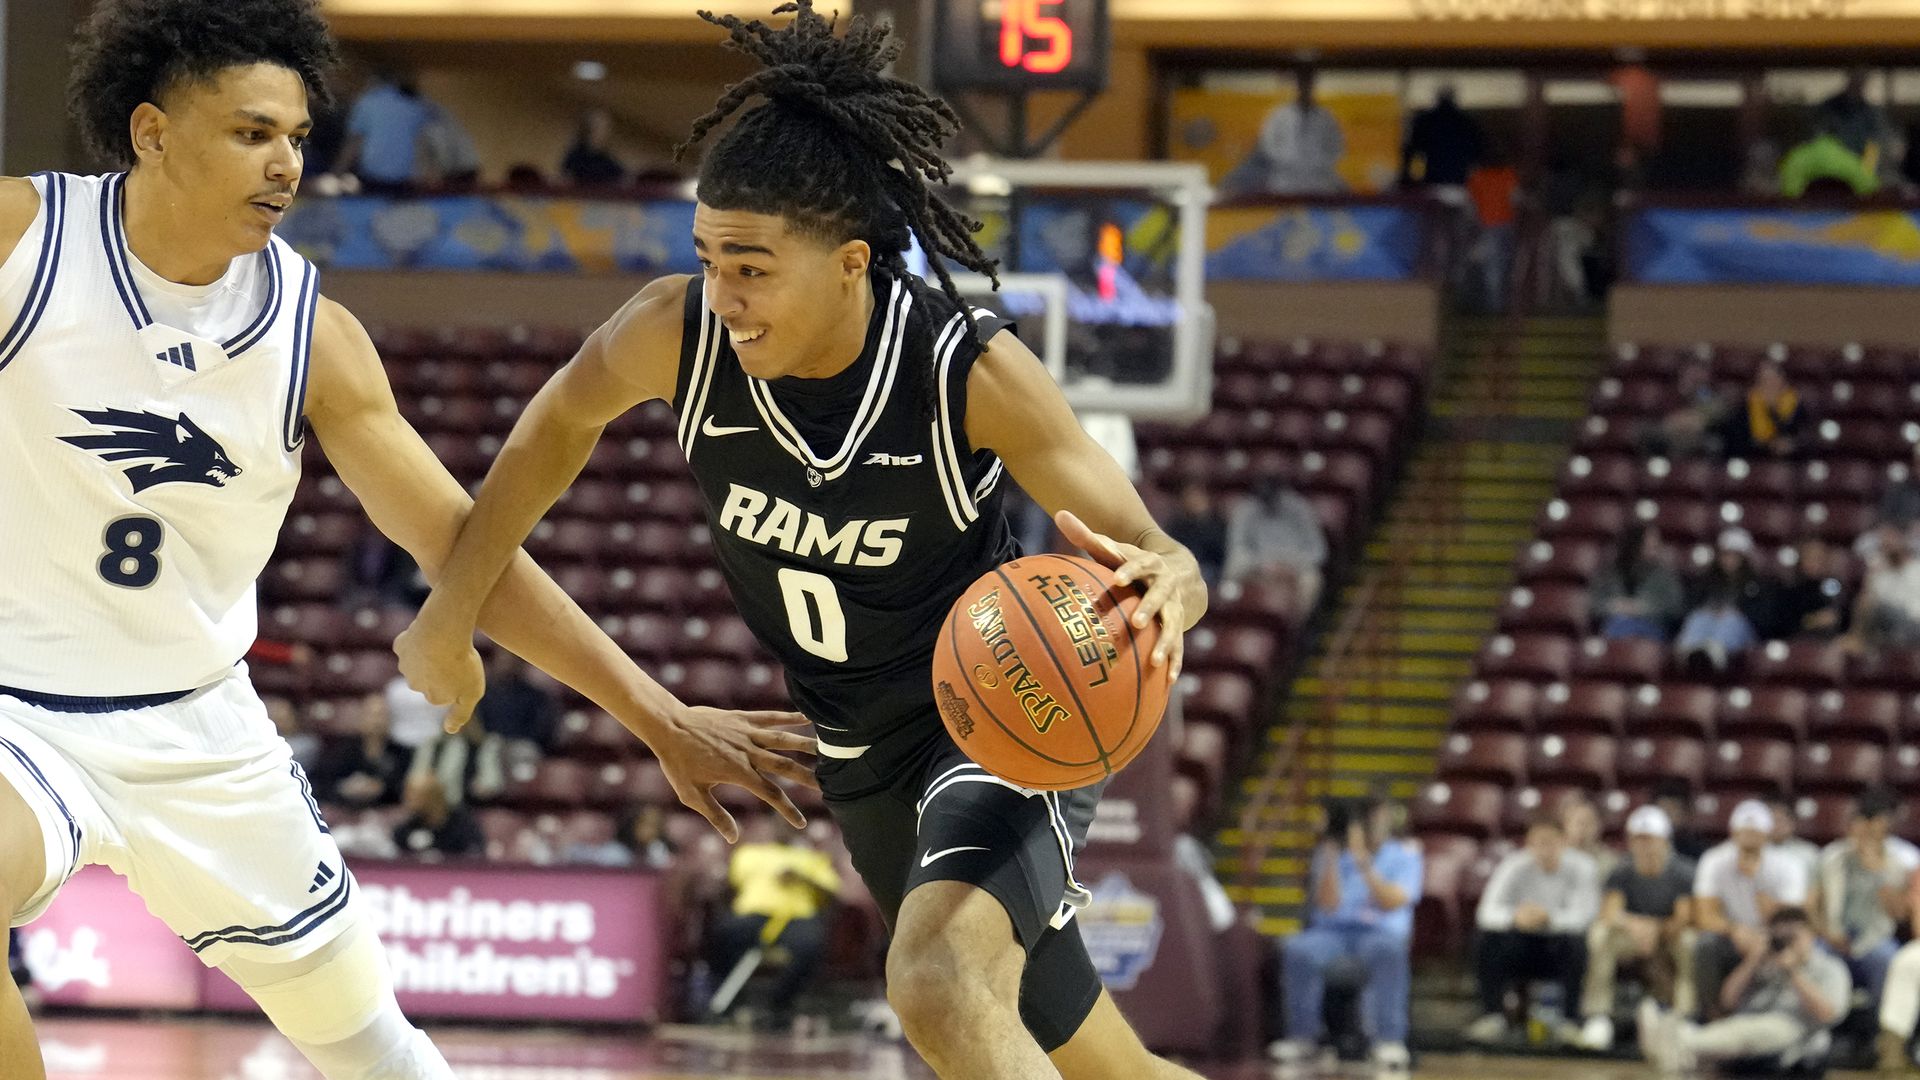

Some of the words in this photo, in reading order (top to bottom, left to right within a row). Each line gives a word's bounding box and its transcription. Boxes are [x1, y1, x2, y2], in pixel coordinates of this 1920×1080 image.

[1000, 0, 1072, 73] 15
[862, 452, 923, 467] A10
[96, 512, 165, 591] 8
[719, 482, 910, 567] RAMS
[777, 567, 849, 663] 0
[1028, 574, 1111, 689] LEGACY
[967, 587, 1072, 735] SPALDING
[361, 884, 594, 942] Shriners
[382, 942, 618, 998] hildren's
